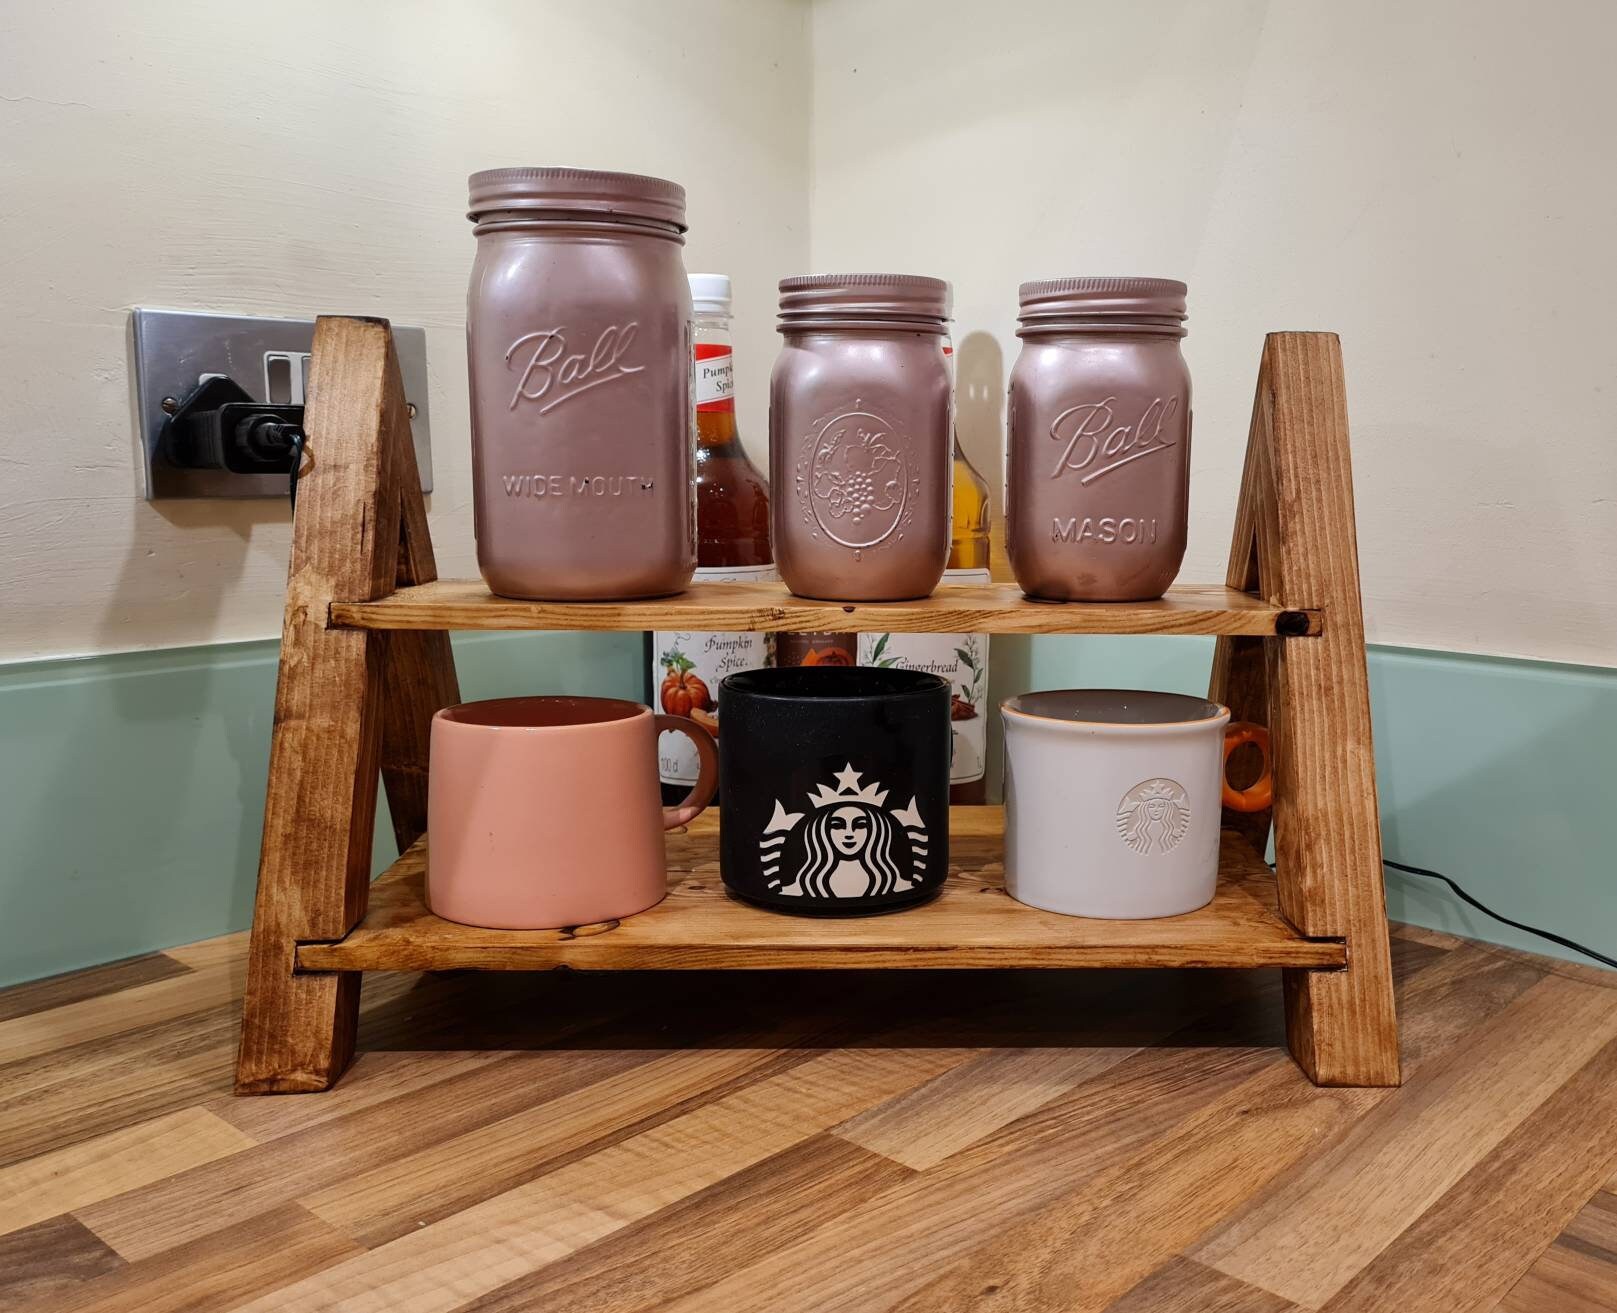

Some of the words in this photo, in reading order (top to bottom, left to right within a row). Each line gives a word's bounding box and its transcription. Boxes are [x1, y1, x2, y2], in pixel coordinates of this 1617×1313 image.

[504, 321, 646, 416] Ball
[1050, 395, 1178, 487] Ball
[503, 475, 563, 497] WIDE
[570, 475, 655, 497] MOUTH
[1051, 517, 1158, 544] MASON
[704, 634, 752, 654] Pumpkin
